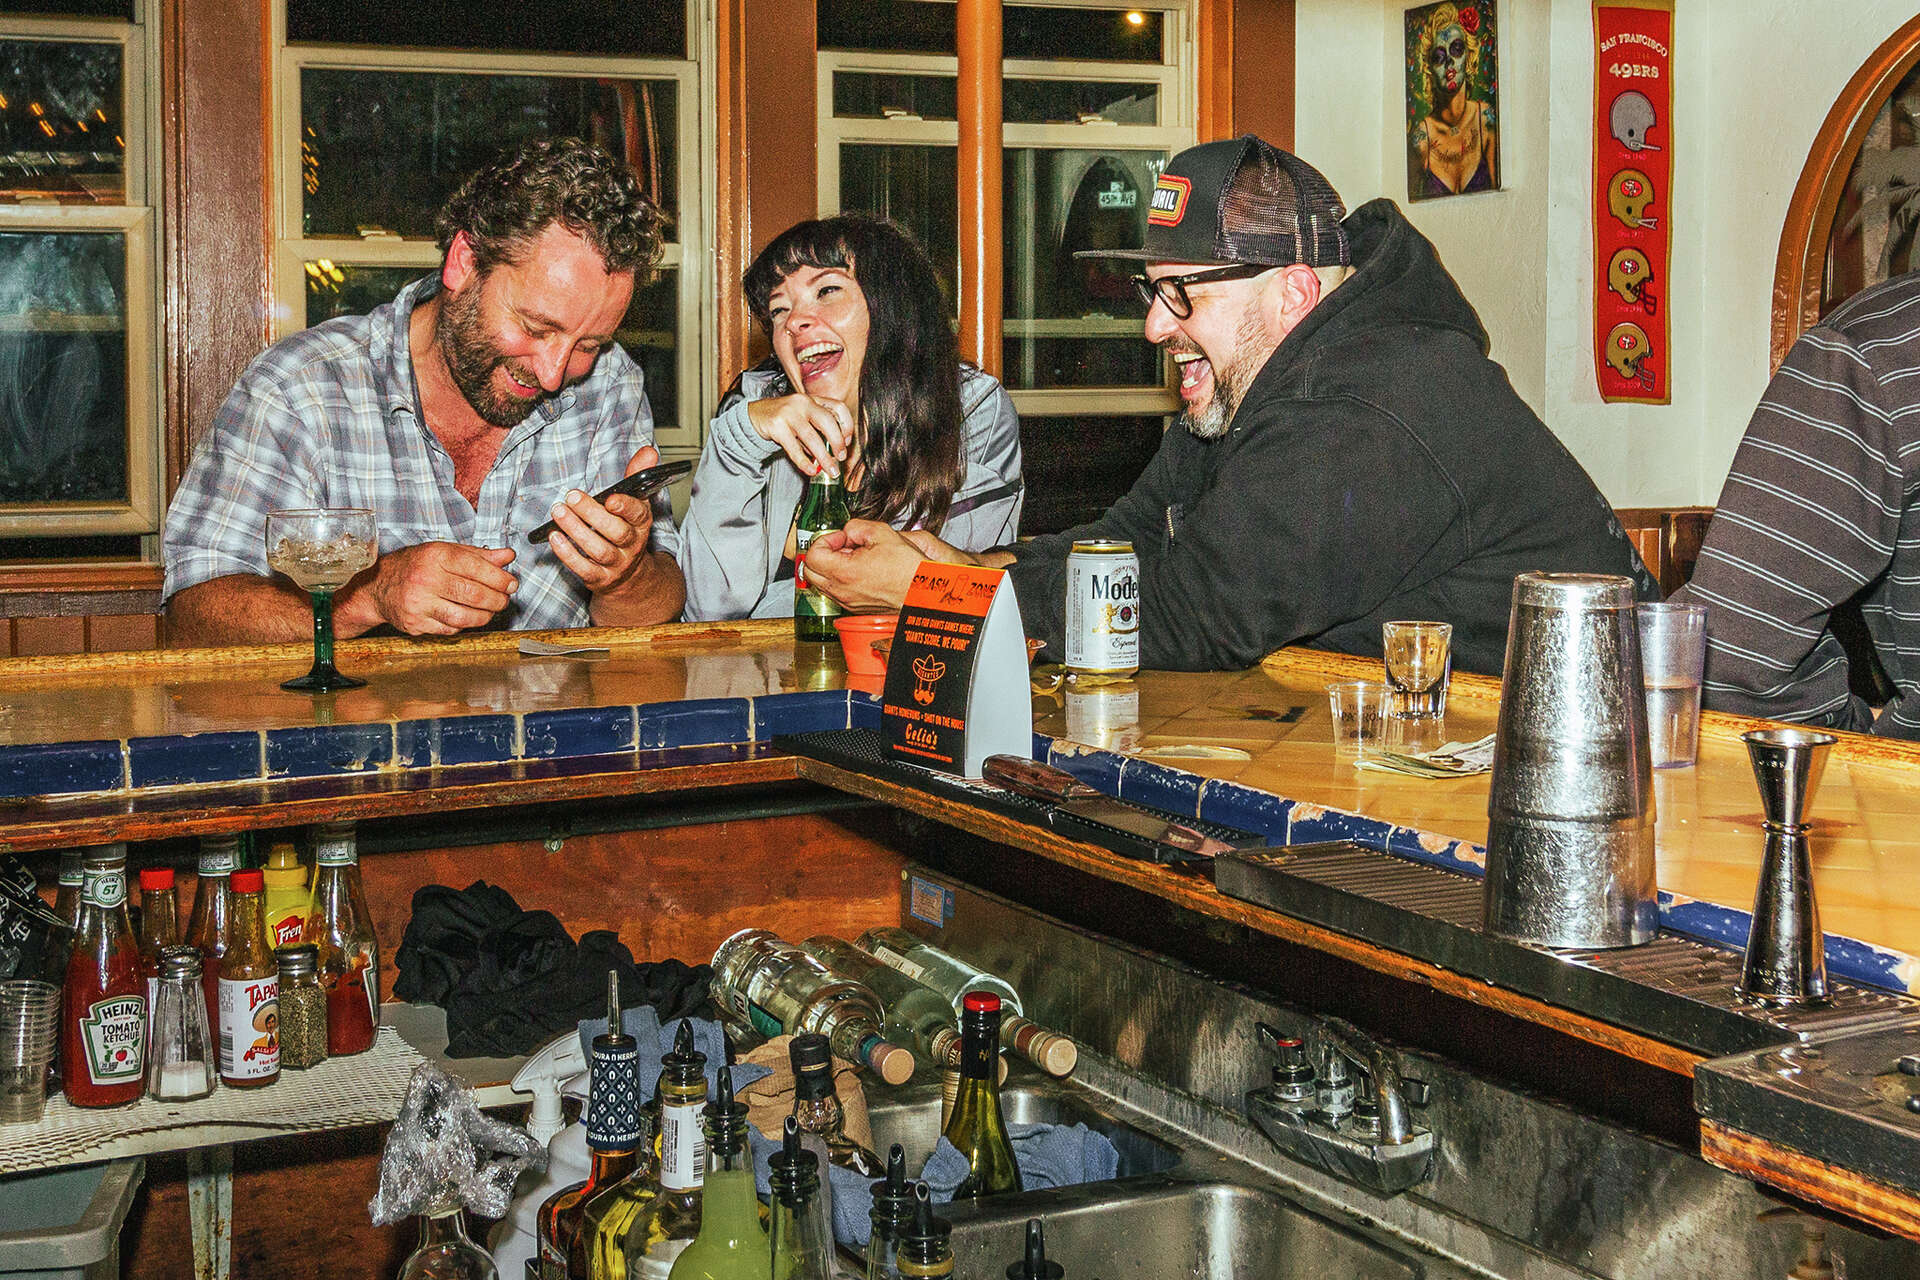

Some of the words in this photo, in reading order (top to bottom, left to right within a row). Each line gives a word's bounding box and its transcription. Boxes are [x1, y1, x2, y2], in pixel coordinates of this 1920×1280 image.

[1600, 36, 1617, 53] SAN
[1618, 32, 1668, 57] FRANCISCO
[1608, 62, 1660, 79] 49ERS
[905, 722, 938, 746] Celia's
[102, 1003, 140, 1020] HEINZ
[101, 1020, 140, 1035] TOMATO
[103, 1031, 140, 1043] KETCHUP
